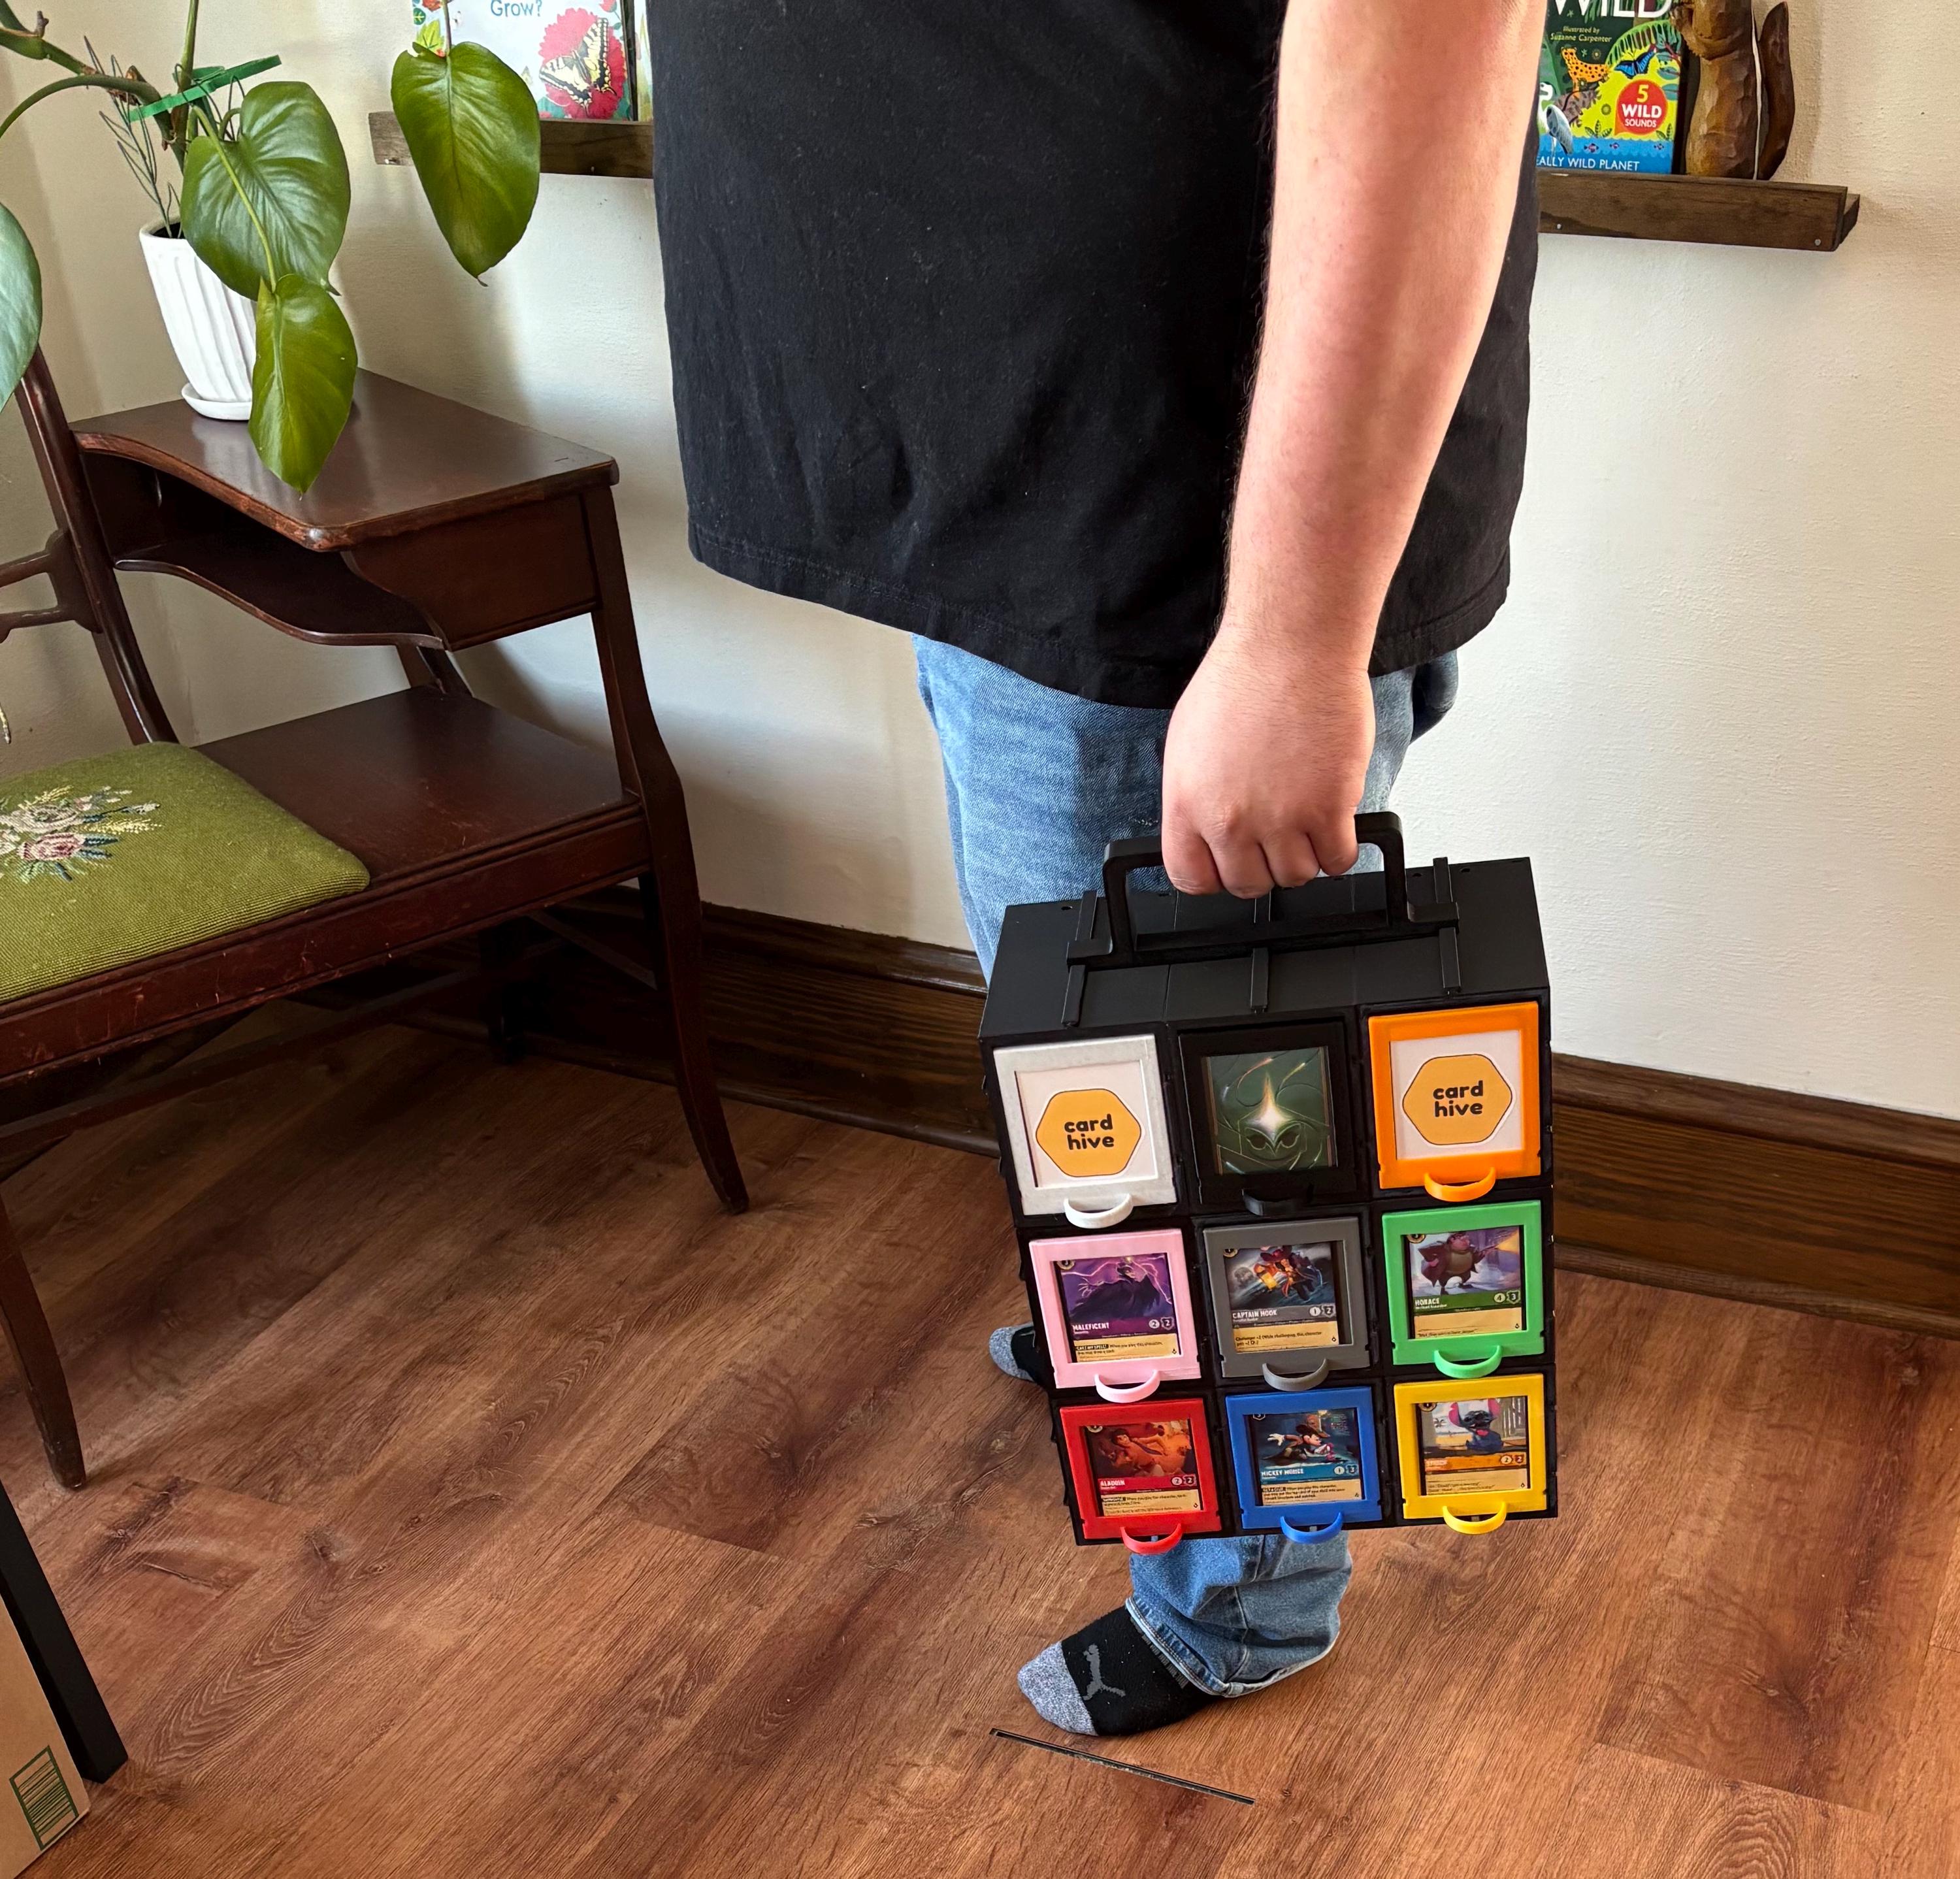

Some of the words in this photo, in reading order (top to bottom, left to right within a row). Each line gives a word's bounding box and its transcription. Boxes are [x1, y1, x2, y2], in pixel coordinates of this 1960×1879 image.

[491, 0, 542, 17] Grow?
[1578, 34, 1612, 43] Carpenter
[1637, 84, 1649, 103] 5
[1622, 103, 1662, 118] WILD
[1625, 119, 1657, 128] SOUNDS
[1567, 157, 1596, 169] WILD
[1599, 159, 1640, 171] PLANET
[1433, 1080, 1483, 1100] card
[1435, 1100, 1483, 1117] hive
[1064, 1114, 1113, 1133] card
[1067, 1134, 1115, 1150] hive
[1415, 1298, 1440, 1306] HORACE
[1232, 1311, 1259, 1319] CAPTAIN
